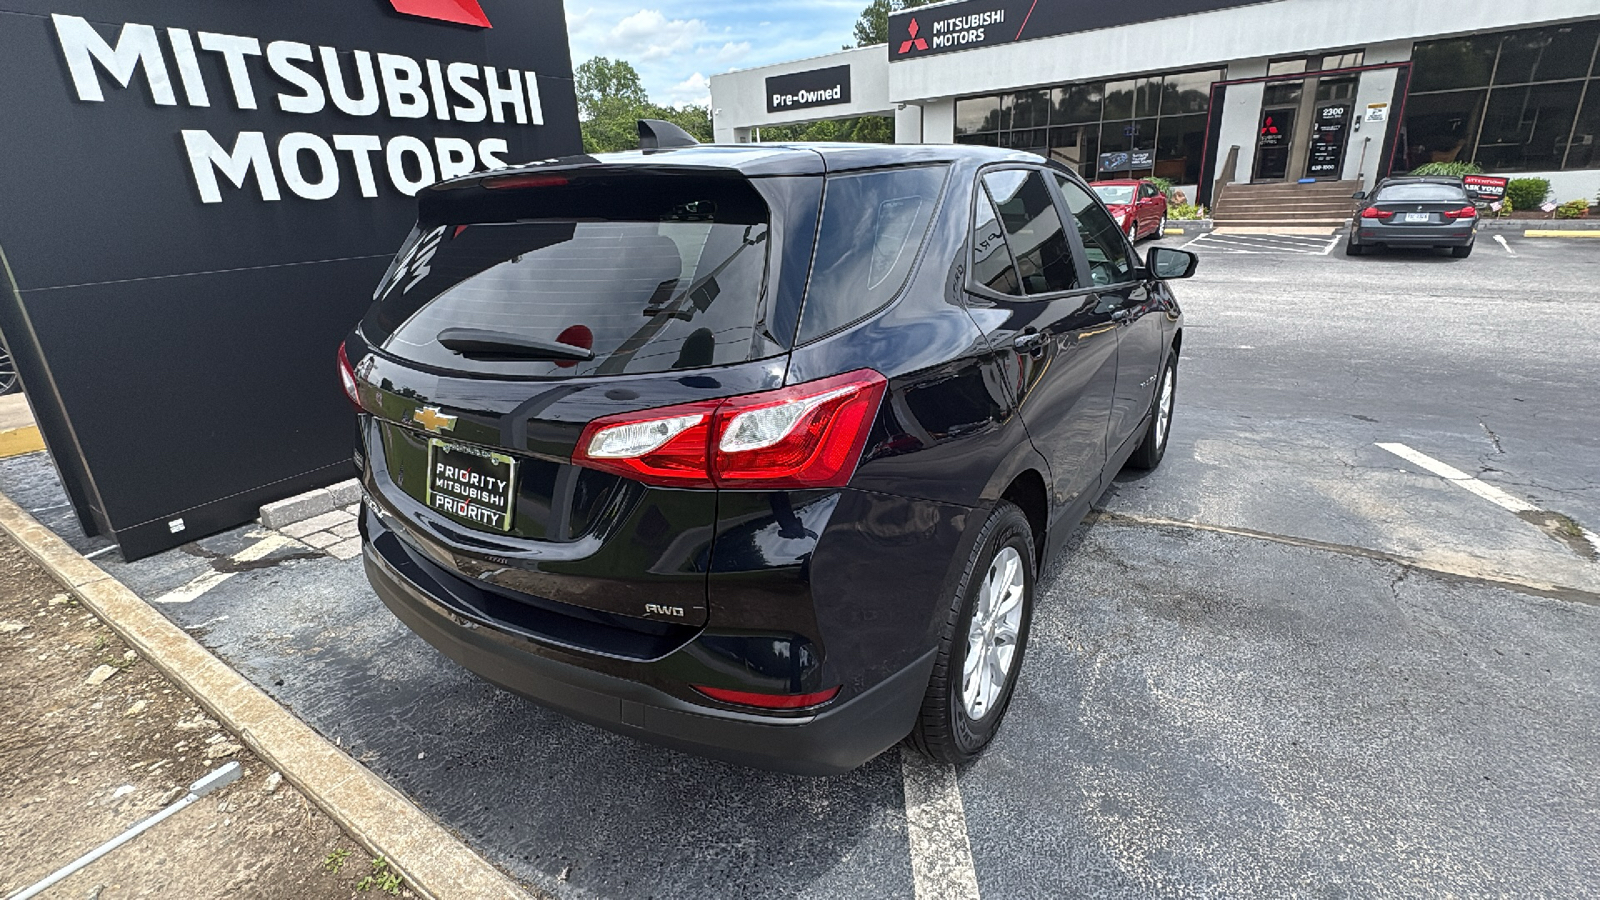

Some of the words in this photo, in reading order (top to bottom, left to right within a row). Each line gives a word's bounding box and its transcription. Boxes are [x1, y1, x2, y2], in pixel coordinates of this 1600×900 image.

[933, 9, 1005, 34] MITSUBISHI
[932, 28, 985, 49] MOTORS
[51, 13, 544, 126] MITSUBISHI
[772, 84, 841, 107] Pre-Owned
[1322, 107, 1344, 116] 2300
[436, 462, 507, 493] PRIORITY
[436, 477, 504, 507] MITSUBISHI
[435, 495, 500, 526] PRIORITY
[645, 603, 684, 617] AWD
